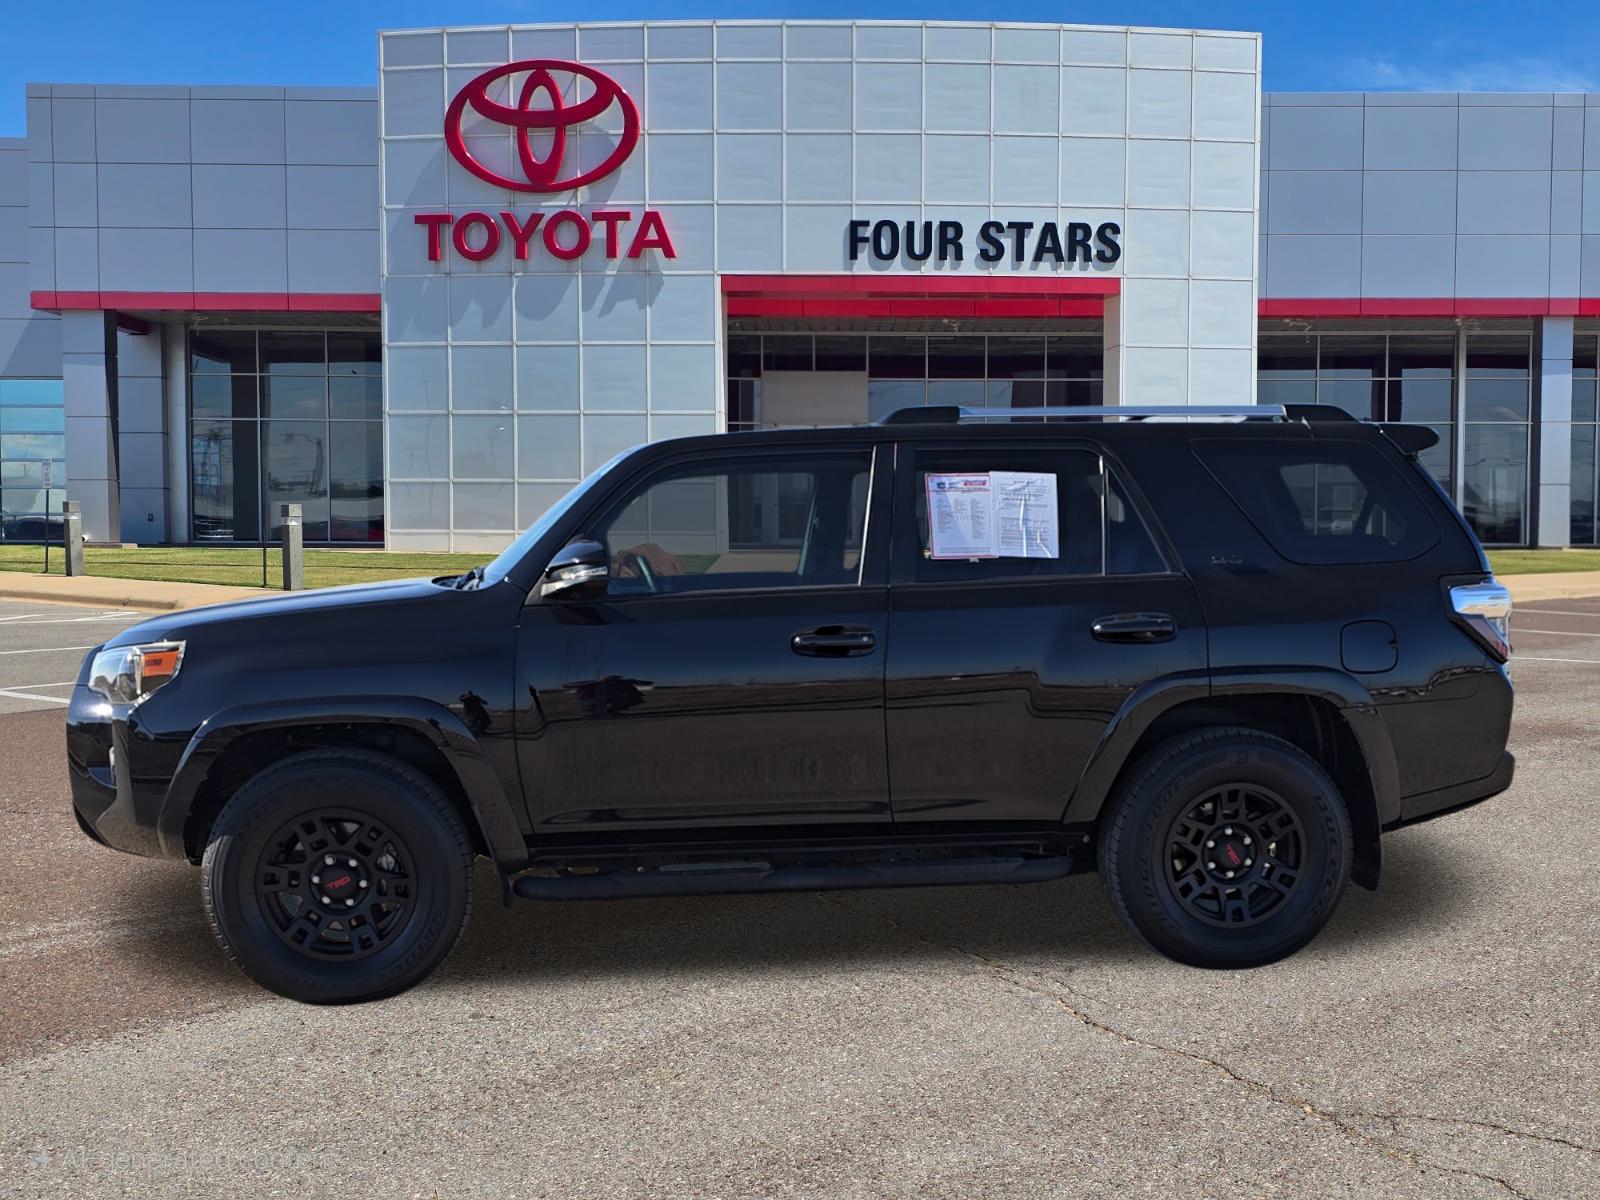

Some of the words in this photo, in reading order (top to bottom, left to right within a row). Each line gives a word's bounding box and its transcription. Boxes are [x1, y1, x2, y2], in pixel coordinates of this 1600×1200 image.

[414, 210, 677, 261] TOYOTA
[849, 220, 963, 261] FOUR
[979, 221, 1121, 263] STARS
